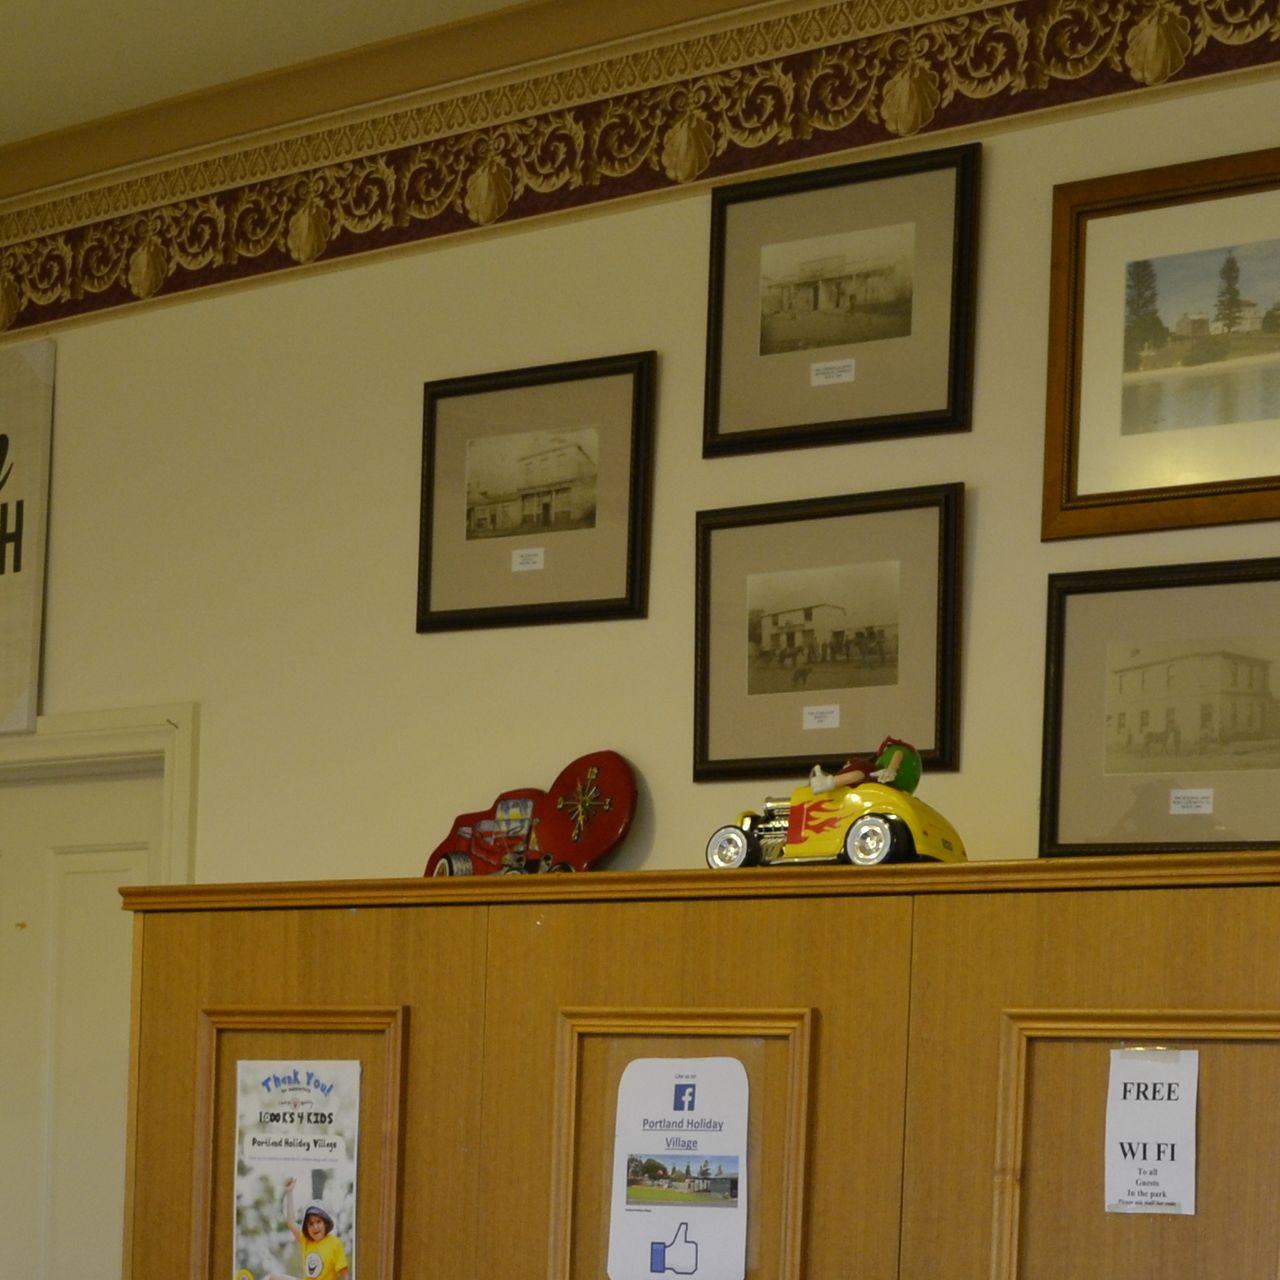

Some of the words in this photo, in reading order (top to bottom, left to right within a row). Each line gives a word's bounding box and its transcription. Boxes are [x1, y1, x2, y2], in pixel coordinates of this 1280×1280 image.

[262, 1069, 300, 1093] Thank
[306, 1072, 334, 1097] You!
[1122, 1082, 1180, 1102] FREE
[297, 1111, 304, 1124] 4
[307, 1111, 334, 1124] KIDS
[642, 1118, 684, 1130] Portland
[686, 1118, 724, 1132] Holiday
[252, 1137, 283, 1147] Portland
[284, 1138, 310, 1151] Holiday
[313, 1139, 337, 1152] Village
[665, 1137, 698, 1150] Village
[1119, 1142, 1148, 1161] WI
[1156, 1143, 1176, 1162] FI
[1137, 1167, 1148, 1176] To
[1149, 1168, 1158, 1176] all
[1135, 1179, 1160, 1187] Guests
[1127, 1189, 1136, 1197] In
[1150, 1190, 1167, 1199] park
